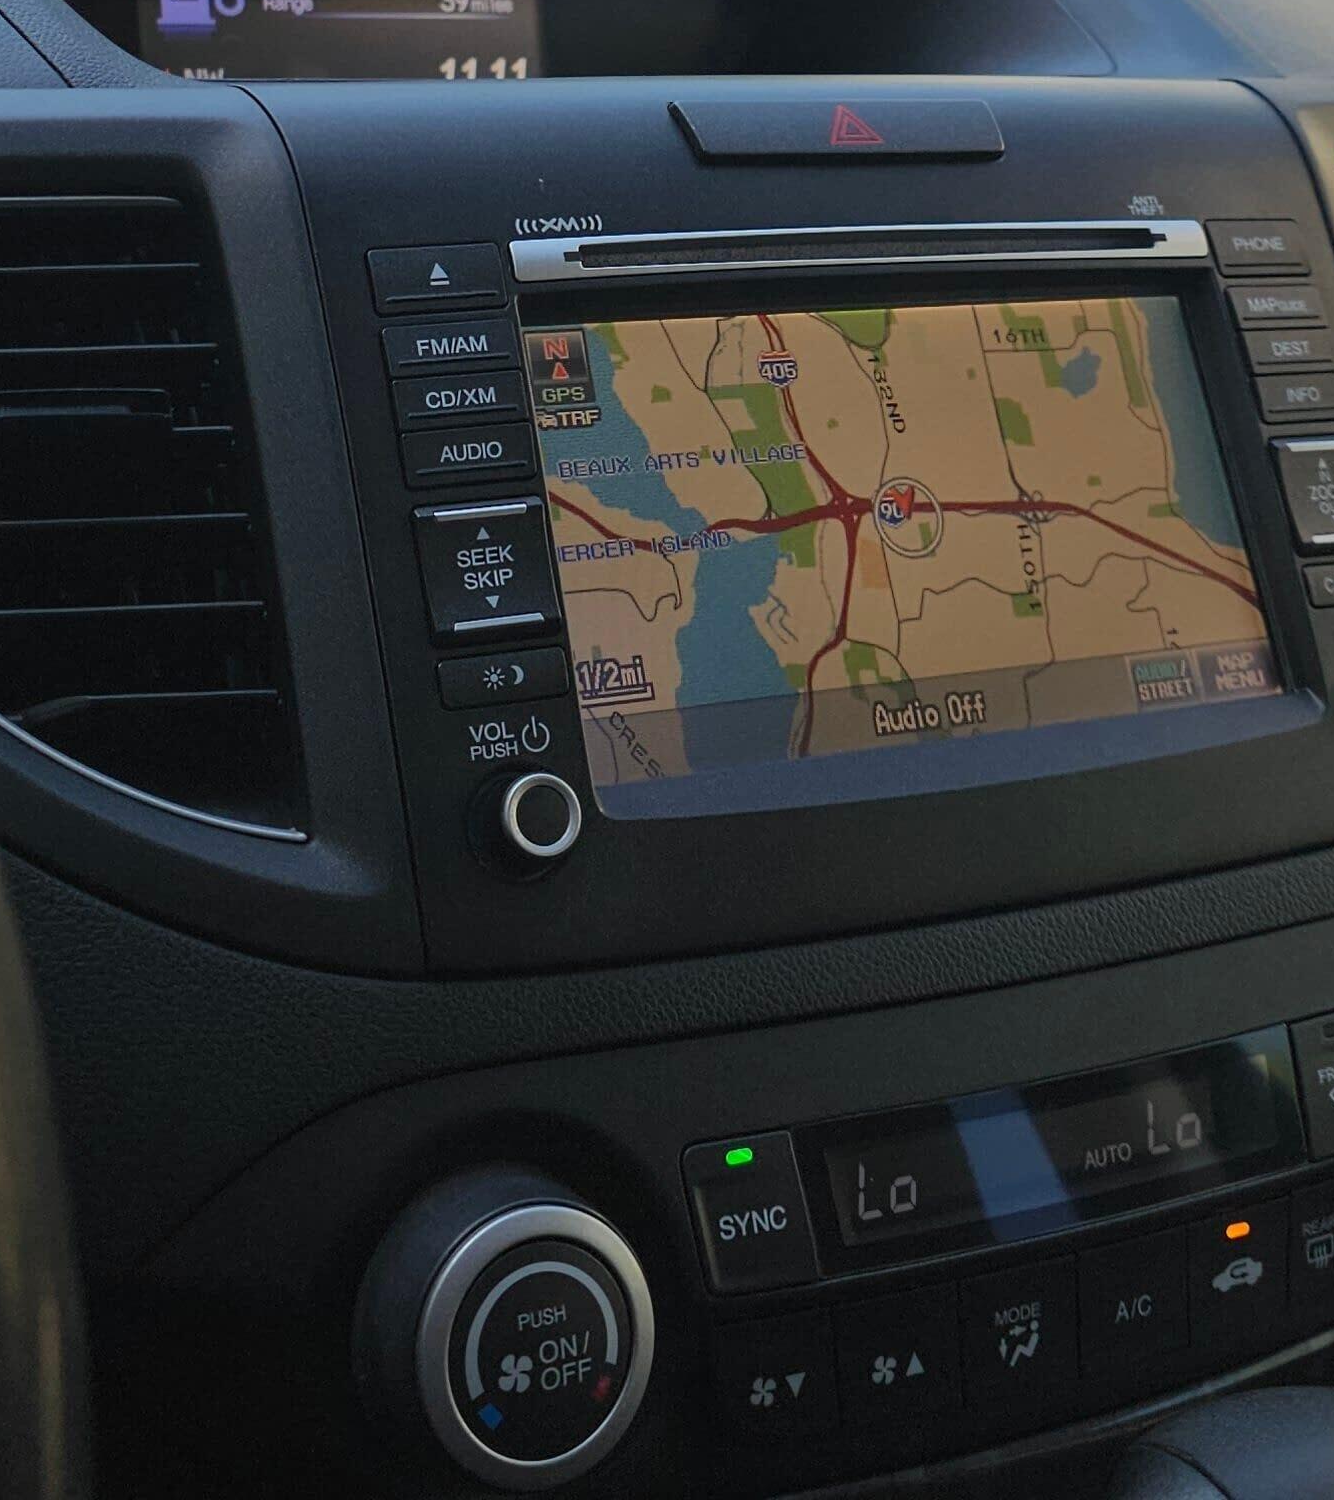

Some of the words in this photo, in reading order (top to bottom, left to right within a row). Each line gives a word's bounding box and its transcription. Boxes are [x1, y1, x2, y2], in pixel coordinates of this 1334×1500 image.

[1233, 237, 1284, 251] PHONE
[416, 335, 488, 356] FM/AM
[993, 329, 1046, 344] 16TH
[543, 337, 569, 360] N
[1271, 341, 1309, 357] DEST
[761, 362, 797, 380] 405
[426, 387, 496, 408] CD/XM
[542, 386, 585, 403] GPS
[867, 354, 906, 434] 132ND
[1286, 387, 1321, 403] INFO
[556, 409, 599, 427] TRF
[440, 441, 503, 463] AUDIO
[558, 456, 632, 479] BEAUX
[645, 450, 700, 473] ARTS
[712, 443, 807, 466] VILLAGE
[457, 544, 515, 568] SEEK
[558, 538, 634, 563] ERCER
[651, 531, 732, 555] ISLAND
[464, 568, 514, 590] SKIP
[1137, 677, 1193, 701] STREET
[874, 701, 940, 734] Audio
[946, 693, 986, 724] Off
[468, 721, 516, 743] VOL
[470, 740, 519, 761] PUSH
[1084, 1142, 1132, 1171] AUTO
[719, 1205, 787, 1241] SYNC
[517, 1304, 567, 1331] PUSH
[994, 1302, 1041, 1327] MODE
[1115, 1294, 1152, 1324] A/C
[539, 1331, 590, 1366] ON/
[540, 1357, 592, 1392] OFF
